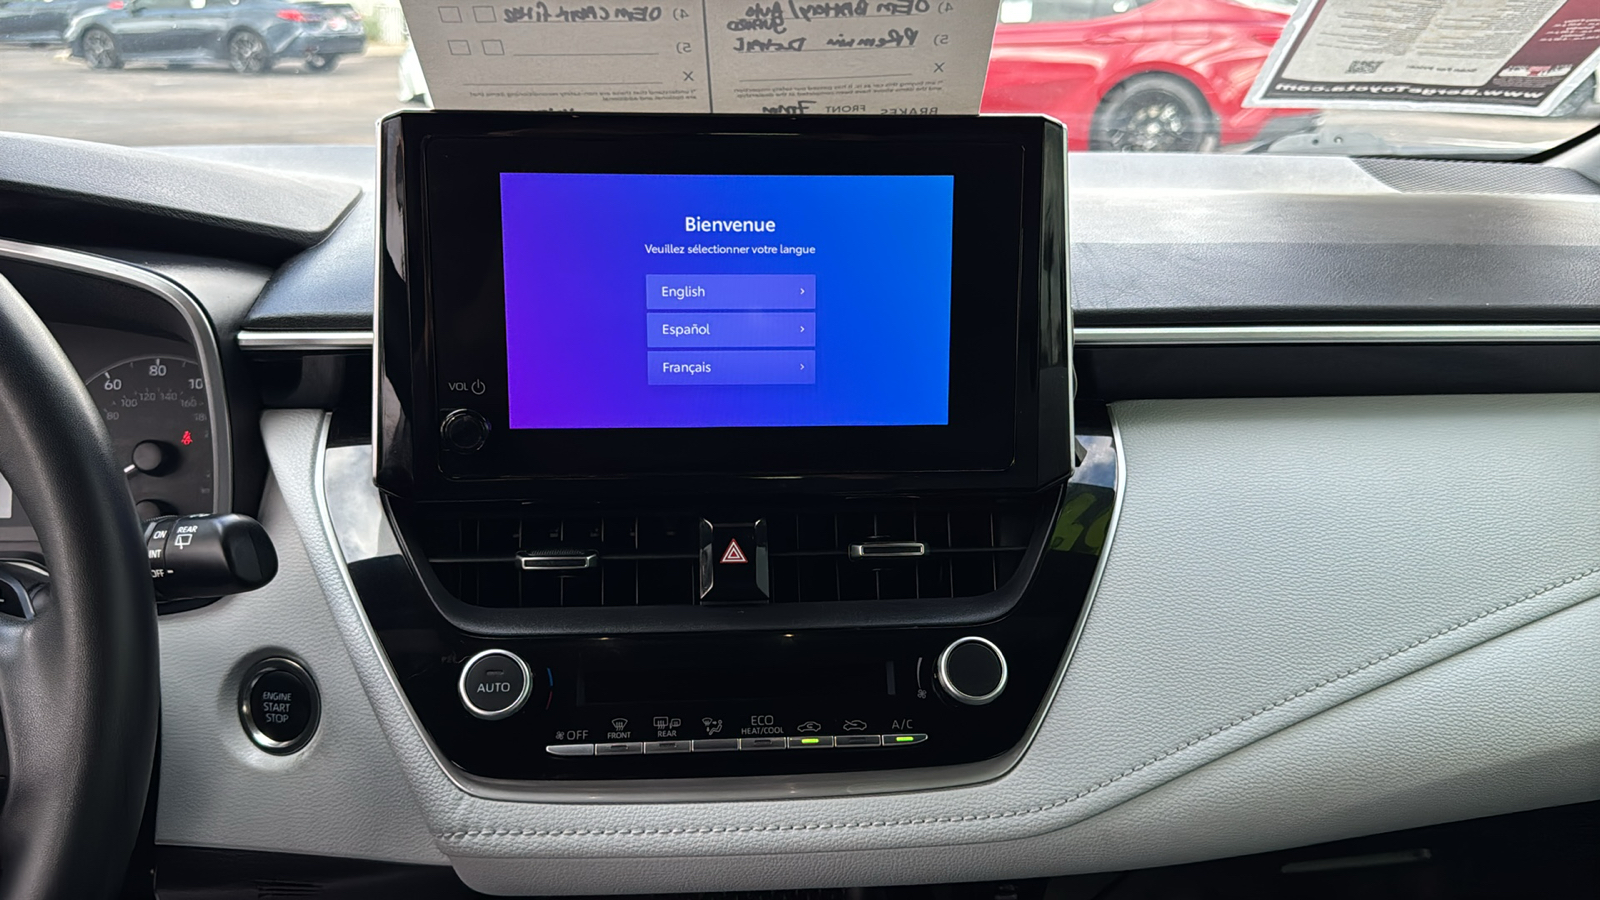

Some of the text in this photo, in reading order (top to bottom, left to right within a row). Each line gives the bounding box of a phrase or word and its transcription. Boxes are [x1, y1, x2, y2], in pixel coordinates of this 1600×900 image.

[685, 216, 776, 232] Bienvenue
[644, 244, 816, 256] Veuillez sélectionner votre langue
[662, 286, 706, 300] English
[662, 323, 710, 337] Español
[148, 364, 167, 376] 80
[662, 362, 712, 376] Français
[104, 378, 122, 390] 60
[448, 382, 468, 390] VOL
[176, 525, 198, 534] REAR
[152, 530, 168, 540] ON
[148, 549, 162, 558] INT
[476, 682, 510, 692] AUTO
[262, 691, 292, 701] ENGINE
[263, 702, 291, 712] START
[266, 712, 290, 723] STOP
[751, 714, 774, 726] ECO
[892, 719, 912, 730] A/C
[566, 730, 589, 740] OFF
[607, 732, 631, 740] FRONT
[657, 730, 677, 738] REAR
[741, 726, 784, 736] HEAT/COOL
